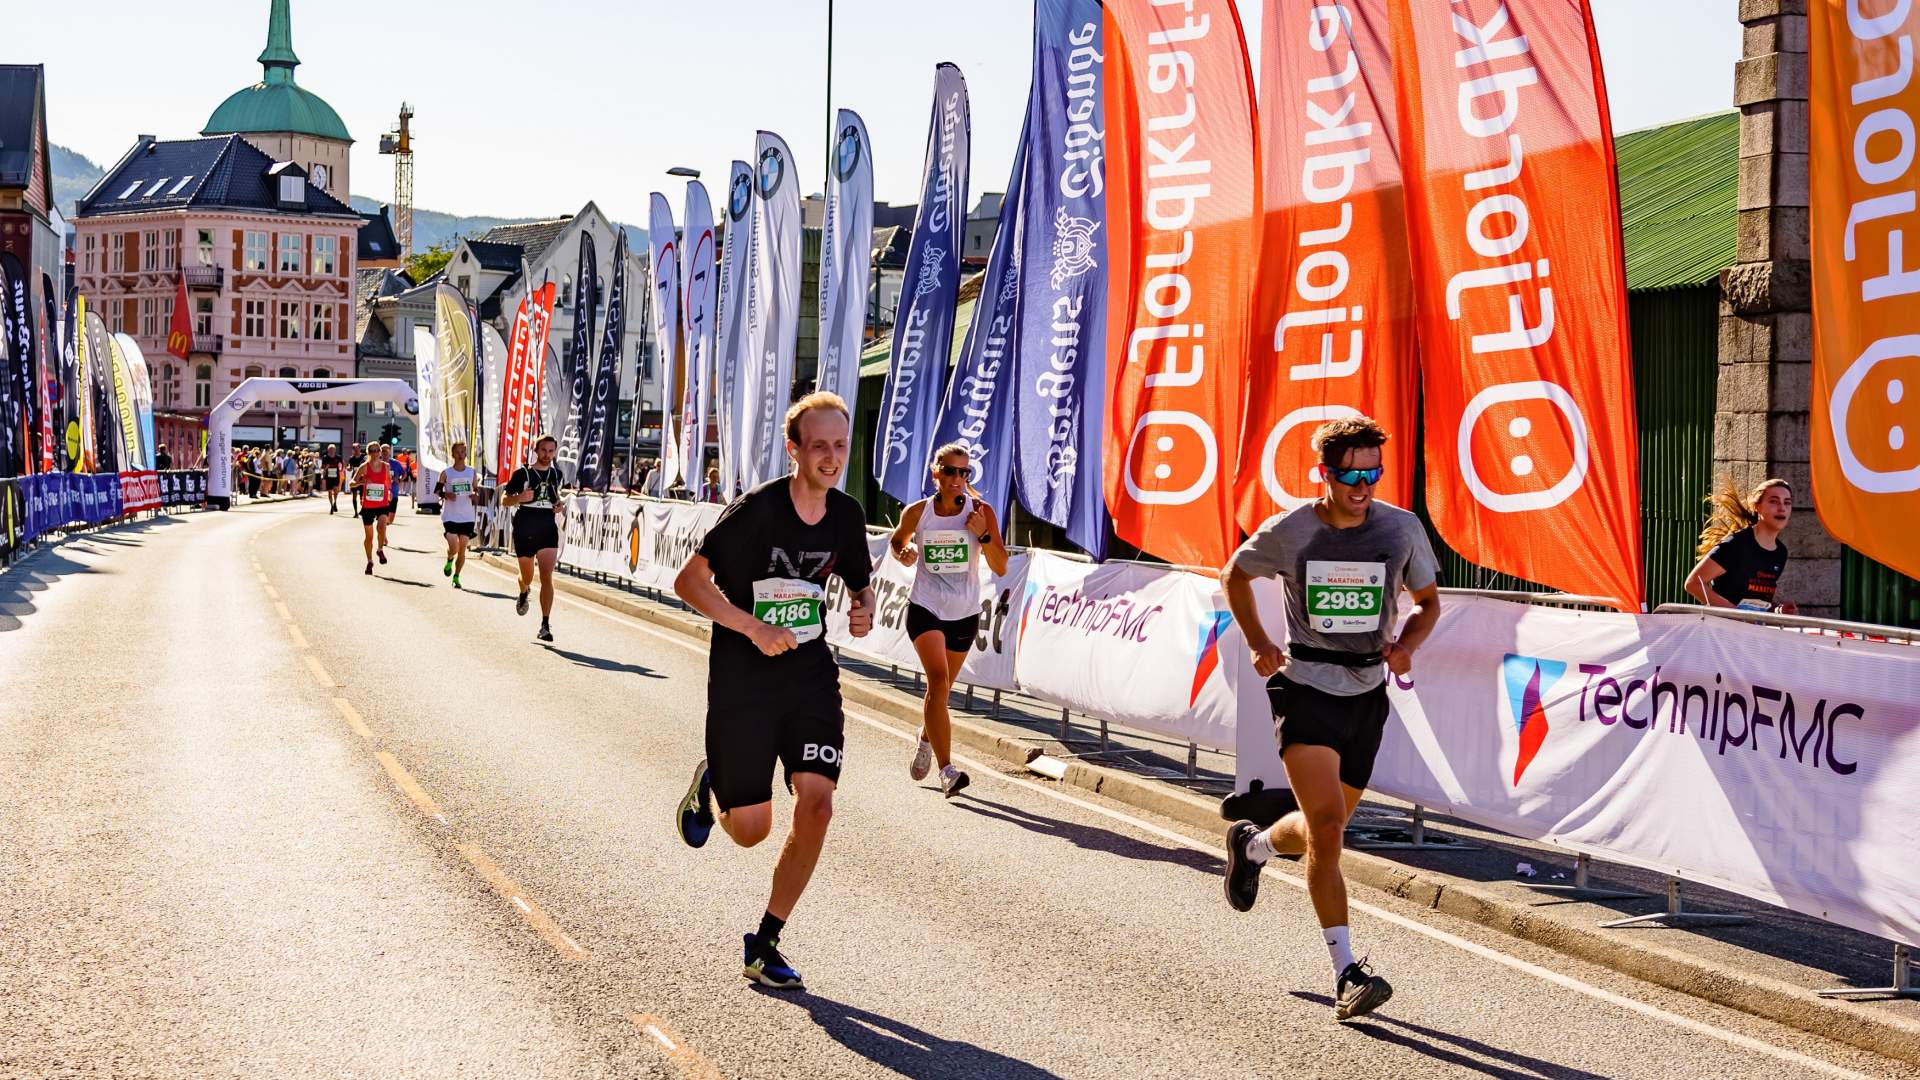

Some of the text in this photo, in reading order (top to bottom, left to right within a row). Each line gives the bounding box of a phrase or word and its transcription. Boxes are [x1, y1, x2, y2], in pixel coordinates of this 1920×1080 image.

[767, 547, 832, 578] N7
[928, 547, 965, 560] 3454
[762, 602, 811, 625] 4186
[1033, 582, 1164, 645] TechnipFMC
[1314, 591, 1375, 611] 2983
[1577, 662, 1866, 775] TechnipFMC
